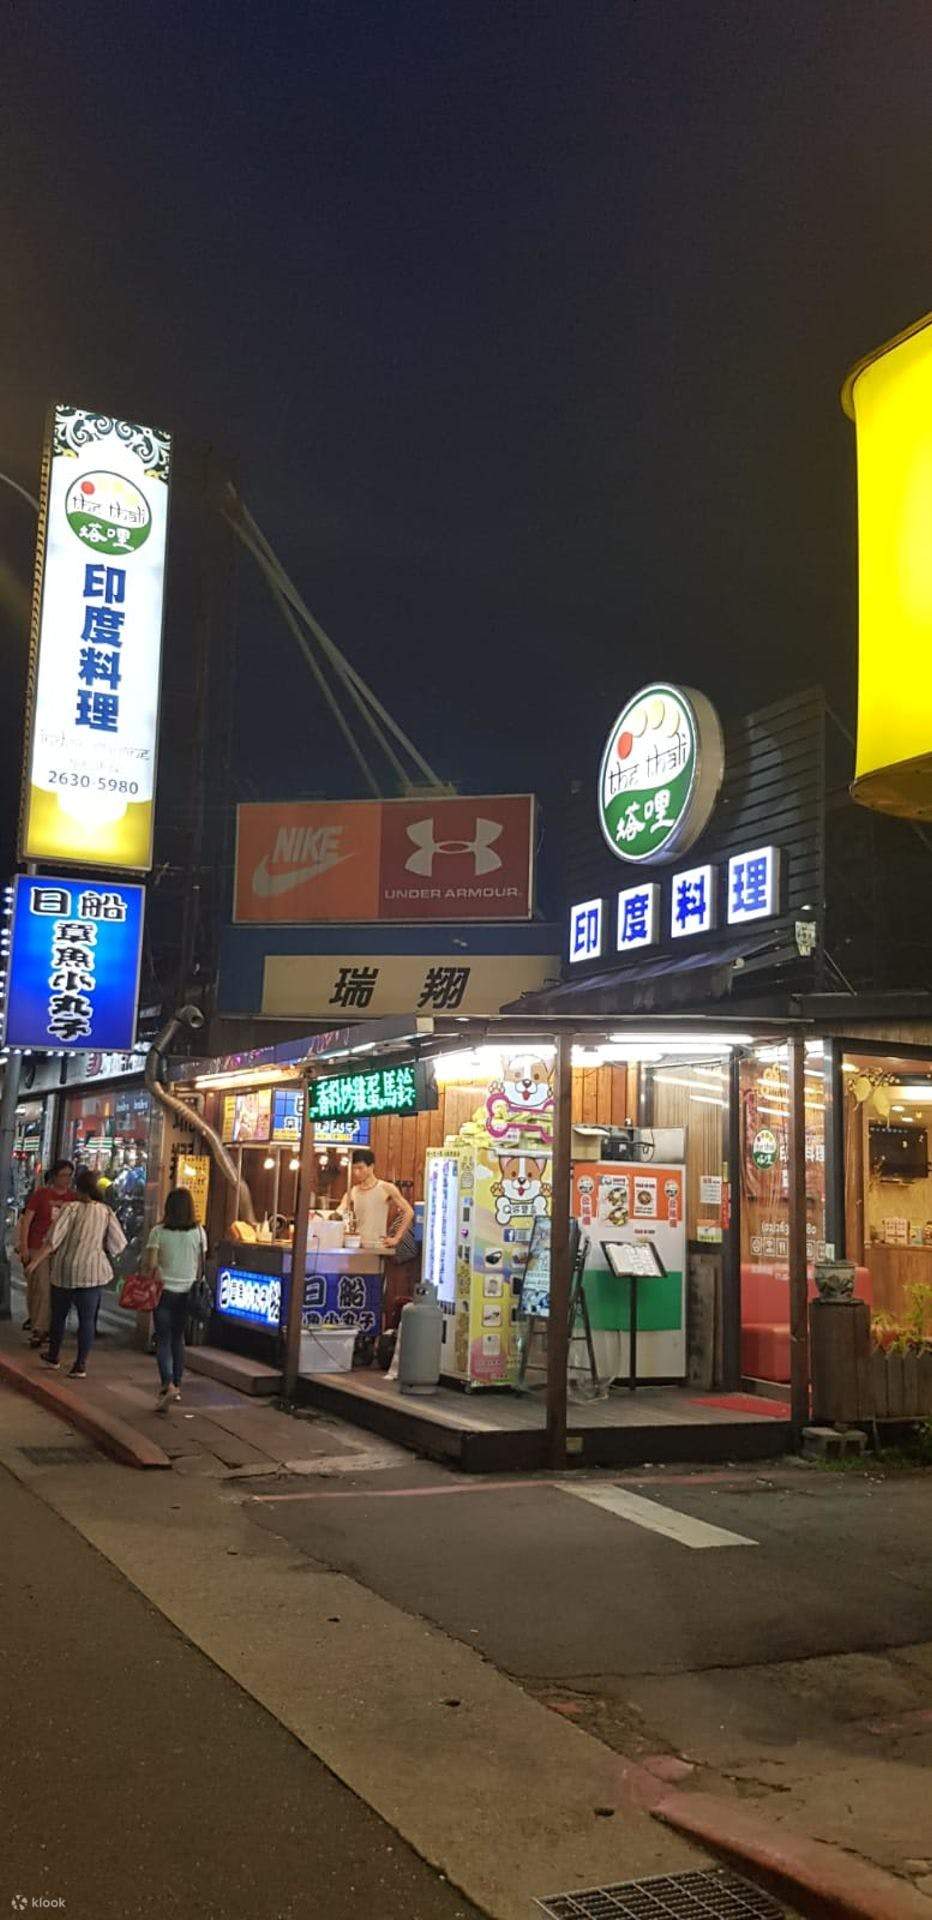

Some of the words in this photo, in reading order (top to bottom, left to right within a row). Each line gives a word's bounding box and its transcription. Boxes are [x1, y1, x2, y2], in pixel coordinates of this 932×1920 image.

[75, 563, 126, 733] 印度料理
[48, 770, 90, 788] 2630
[97, 777, 139, 795] 5980
[271, 826, 344, 863] NIKE
[384, 887, 441, 900] UNDER
[444, 886, 518, 900] ARMOUR
[574, 856, 768, 953] 印度料理
[48, 922, 95, 1040] 章魚小丸子
[328, 966, 470, 1009] 瑞翔
